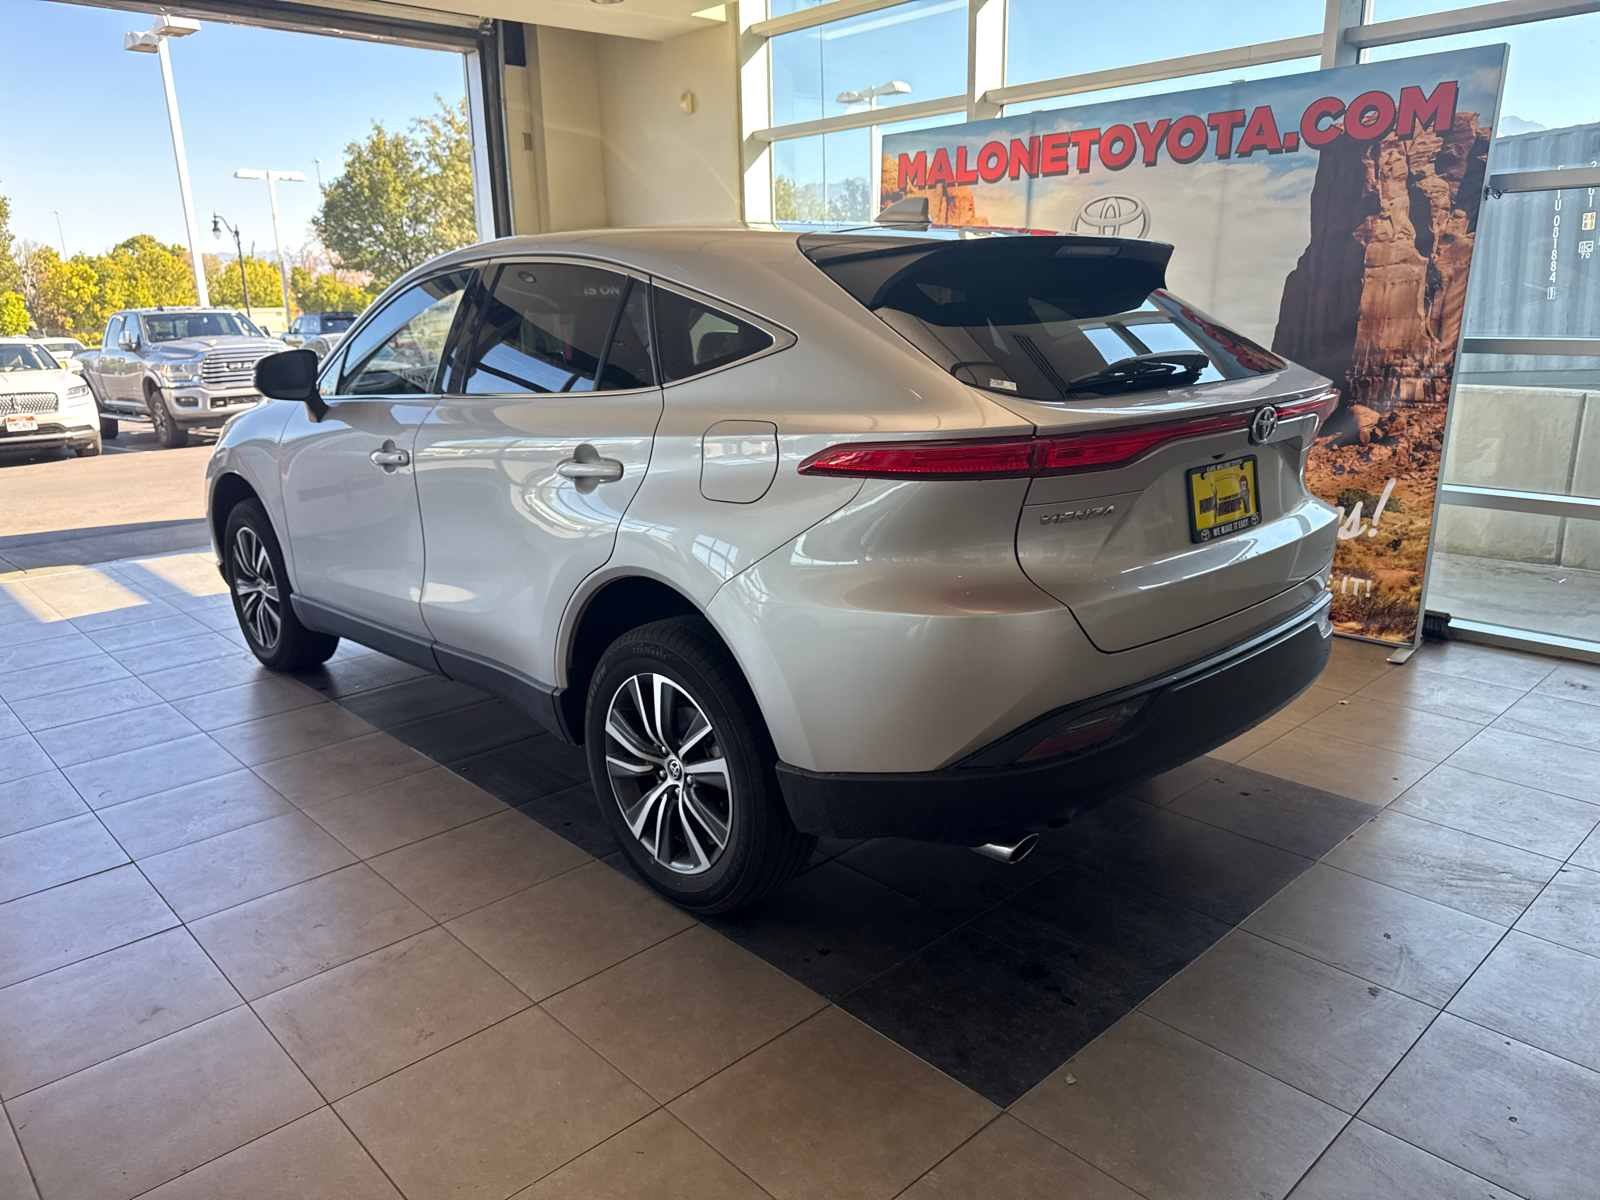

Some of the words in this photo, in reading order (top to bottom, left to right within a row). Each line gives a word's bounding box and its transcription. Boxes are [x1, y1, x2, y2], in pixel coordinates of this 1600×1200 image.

[898, 80, 1459, 191] MALONETOYOTA.COM
[1040, 505, 1115, 526] VENZA
[1213, 527, 1221, 537] WE
[1220, 523, 1233, 535] MAKE
[1238, 518, 1249, 529] EASY
[1341, 576, 1372, 598] IT!
